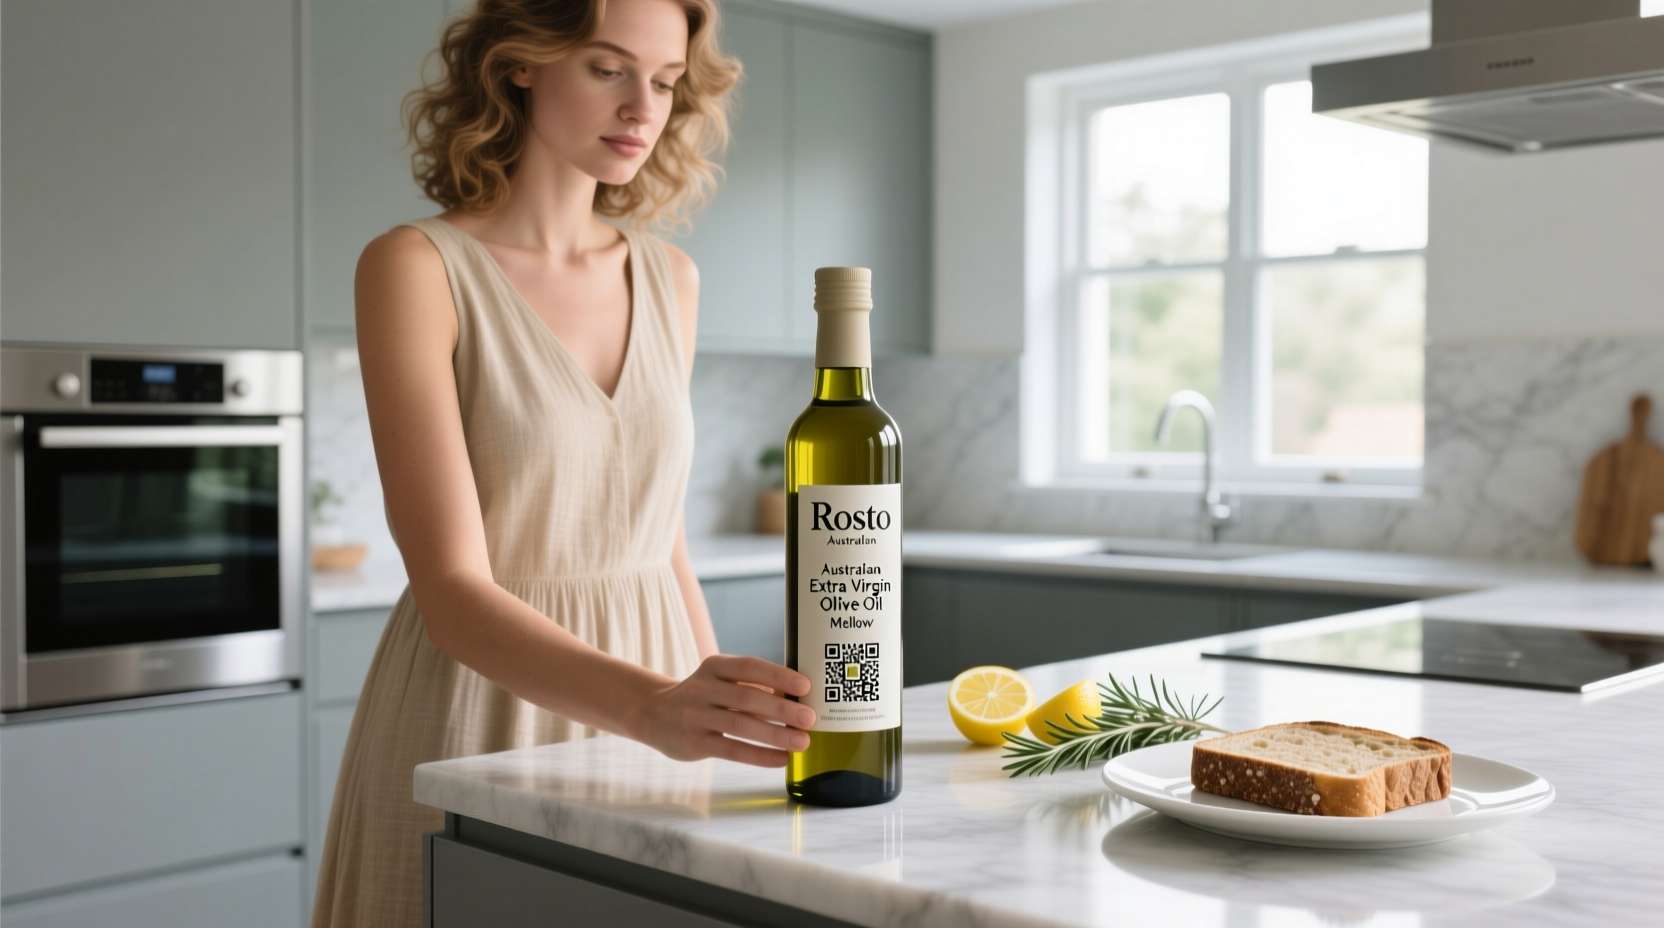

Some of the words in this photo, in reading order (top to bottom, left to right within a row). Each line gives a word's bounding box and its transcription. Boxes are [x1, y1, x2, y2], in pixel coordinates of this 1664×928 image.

[810, 501, 891, 531] Rosto
[810, 578, 847, 593] Extra
[851, 578, 891, 596] Virgin
[820, 596, 860, 611] Olive
[863, 596, 883, 611] Oil
[830, 616, 874, 629] Mellow
